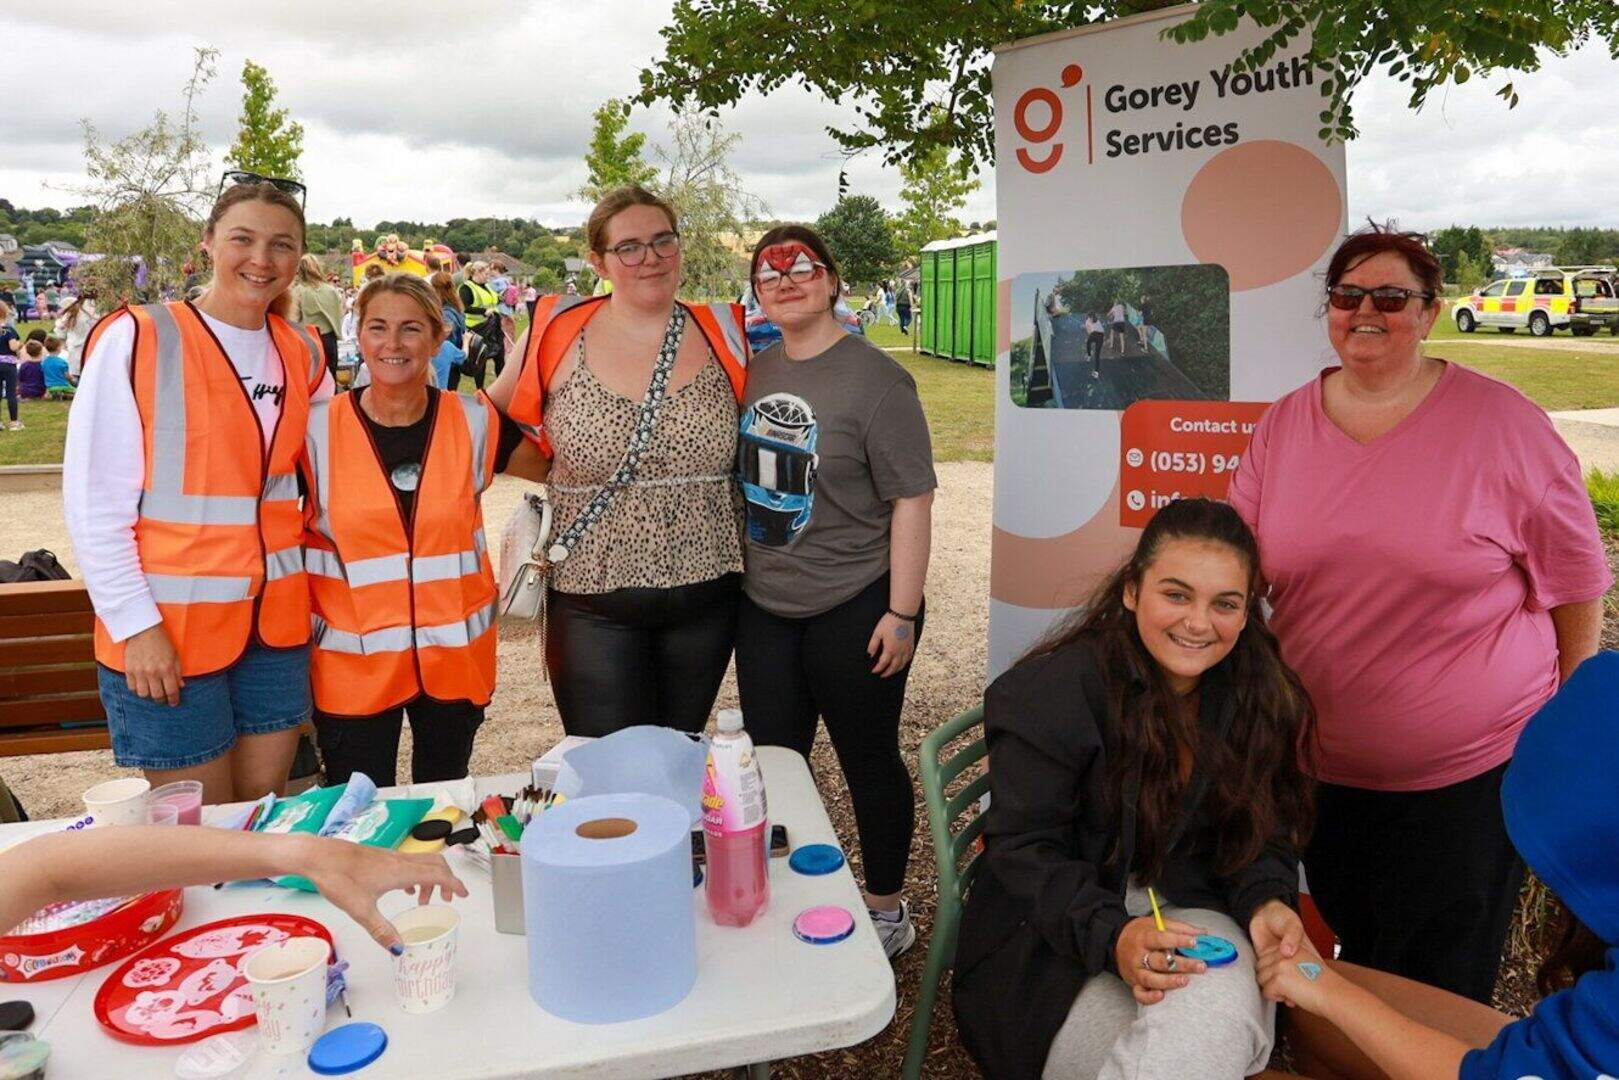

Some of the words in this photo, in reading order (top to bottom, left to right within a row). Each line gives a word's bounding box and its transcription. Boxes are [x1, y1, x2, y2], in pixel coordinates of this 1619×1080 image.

[1104, 78, 1200, 113] Gorey
[1210, 54, 1314, 98] Youth
[1105, 121, 1240, 158] Services
[1170, 417, 1236, 433] Contact
[1151, 451, 1205, 474] (053)
